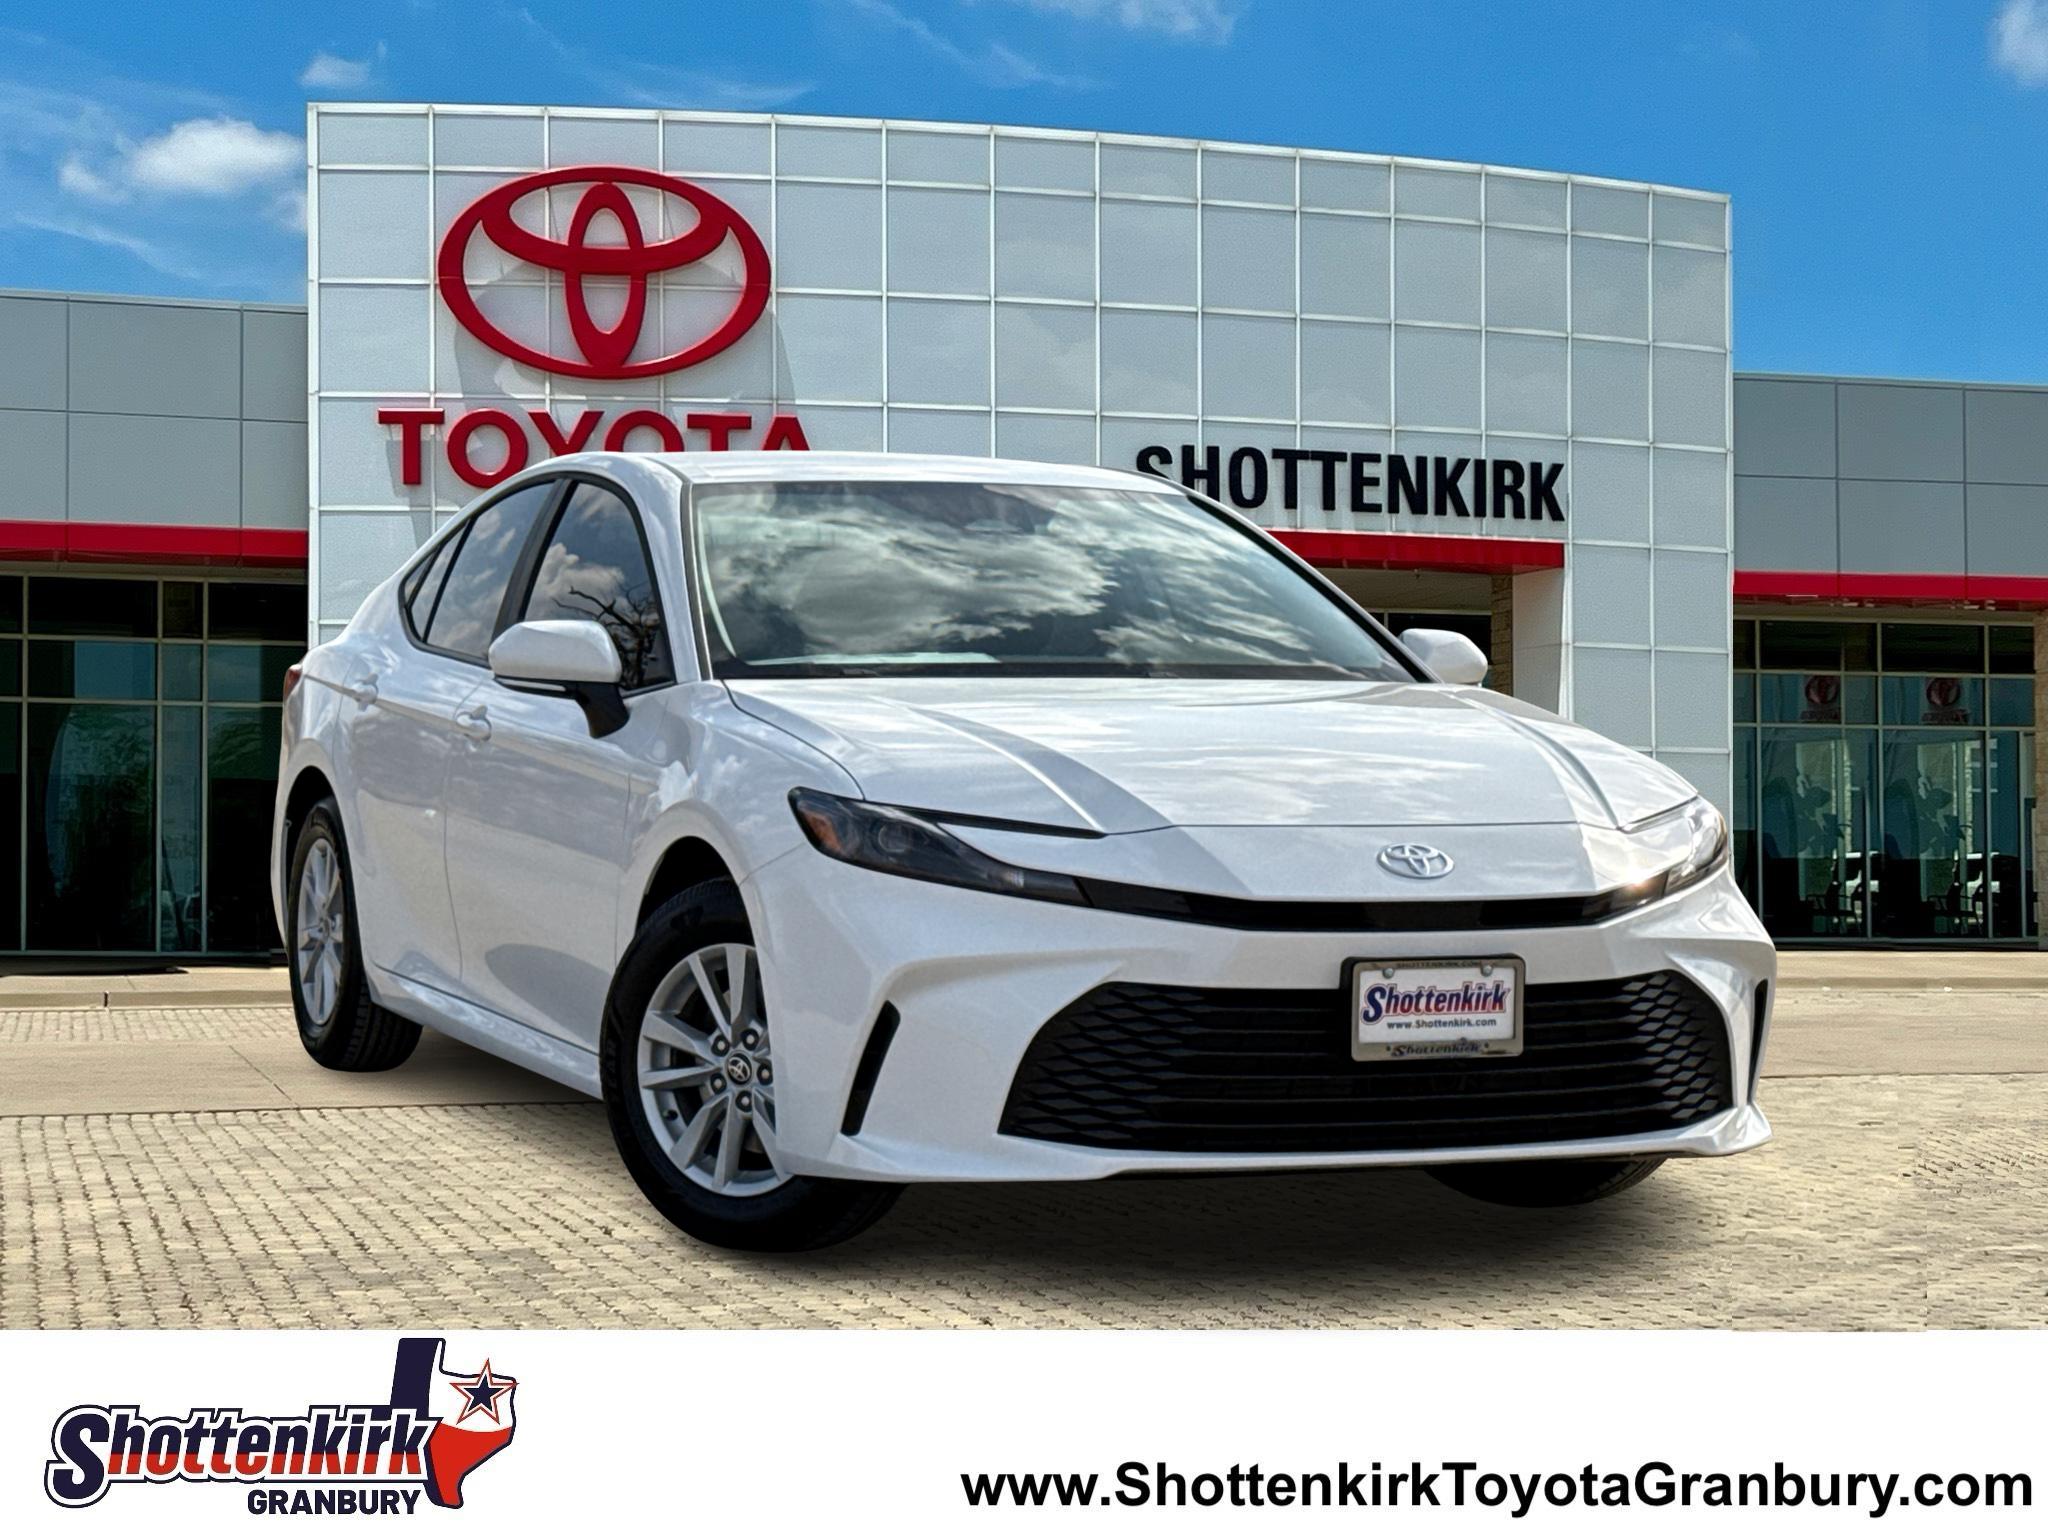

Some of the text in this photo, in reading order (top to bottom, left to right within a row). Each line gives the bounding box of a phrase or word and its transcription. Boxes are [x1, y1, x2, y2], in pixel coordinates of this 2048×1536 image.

[1136, 444, 1565, 522] SHOTTENKIRK
[1361, 984, 1508, 1024] Shottenkirk
[1387, 1017, 1497, 1030] www.Shottenkirk.com
